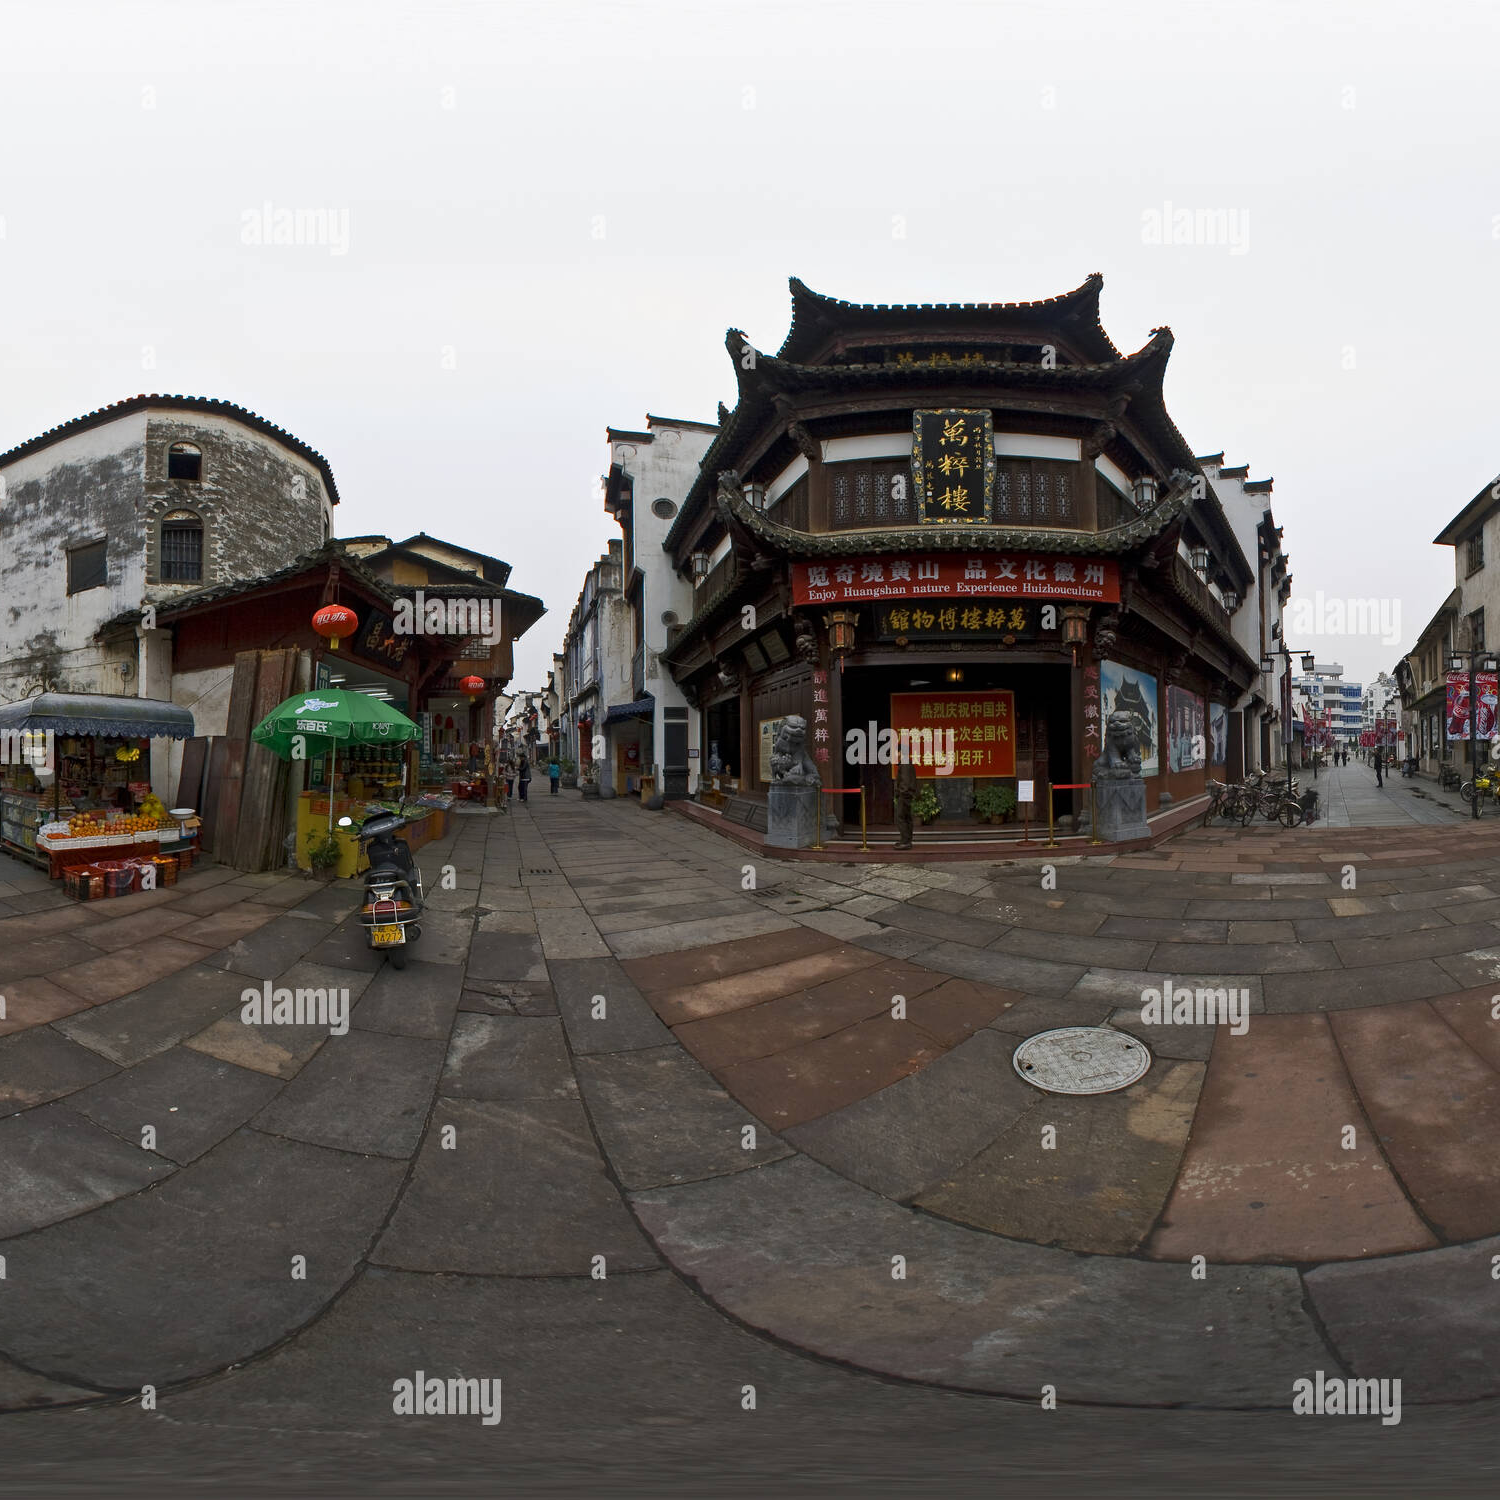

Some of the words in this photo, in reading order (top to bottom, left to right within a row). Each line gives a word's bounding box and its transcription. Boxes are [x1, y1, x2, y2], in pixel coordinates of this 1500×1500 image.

[807, 560, 941, 588] 览奇境黄山
[964, 558, 1106, 586] 品文化徽州
[809, 589, 838, 601] Enjoy
[843, 585, 906, 598] Huangshan
[912, 583, 951, 594] nature
[956, 581, 1018, 594] Experience
[1022, 582, 1104, 598] Huizhouculture
[920, 702, 1008, 719] 热烈庆祝中国共
[296, 719, 329, 734] 乐百氏
